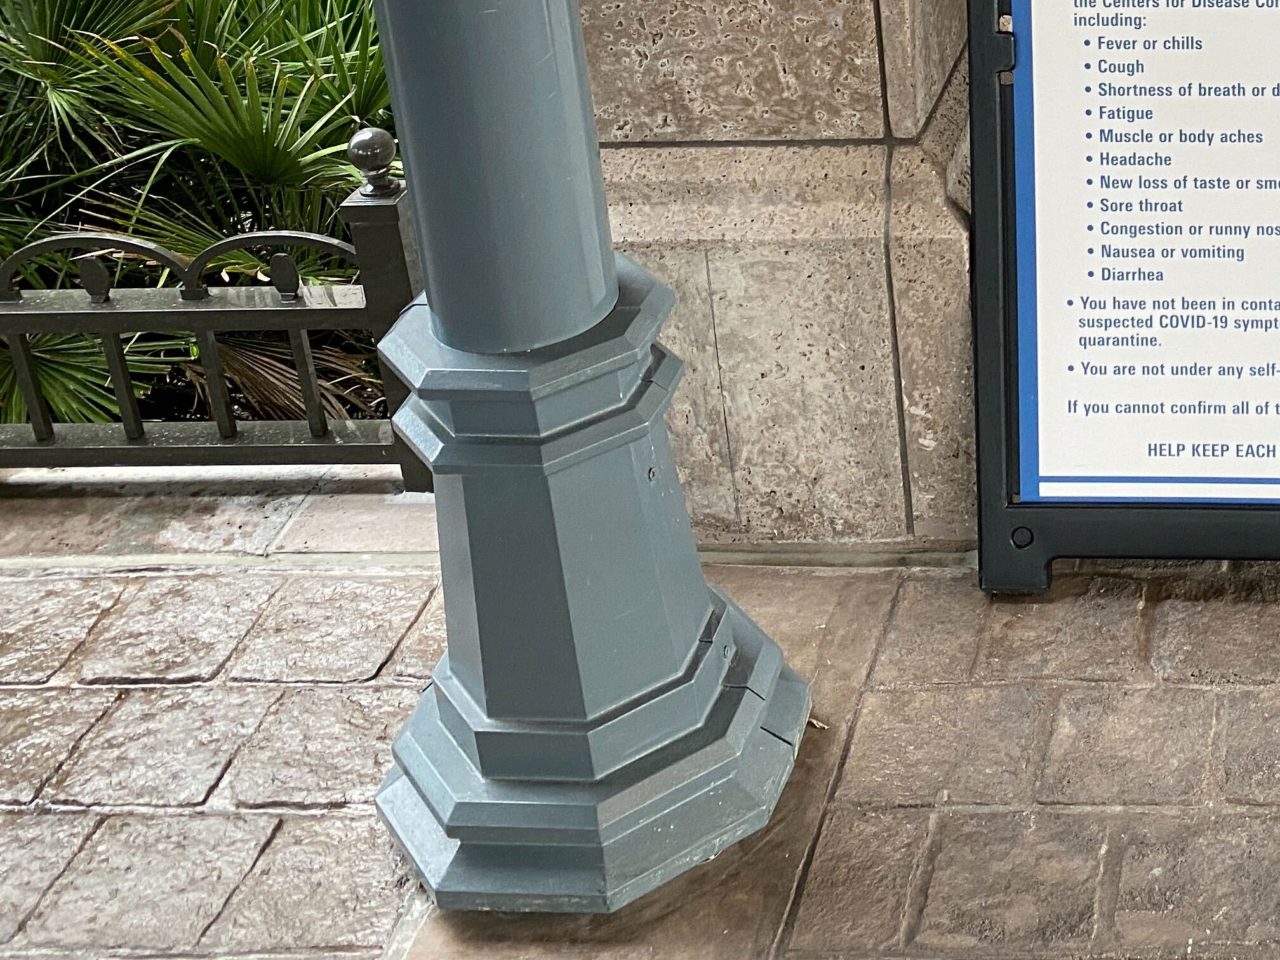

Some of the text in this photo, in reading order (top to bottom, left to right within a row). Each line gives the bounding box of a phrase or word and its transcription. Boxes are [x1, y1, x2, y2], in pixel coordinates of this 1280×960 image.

[1074, 12, 1146, 30] including:
[1098, 36, 1203, 50] Fever or chills
[1098, 59, 1144, 77] Cough
[1098, 82, 1173, 97] Shortness
[1178, 82, 1193, 97] of
[1198, 82, 1246, 97] breath
[1252, 86, 1267, 97] or
[1099, 105, 1153, 123] Fatigue
[1099, 129, 1263, 146] Muscle or body aches
[1100, 152, 1172, 166] Headache
[1100, 175, 1133, 189] New
[1139, 175, 1168, 189] loss
[1173, 175, 1188, 189] of
[1193, 177, 1230, 190] taste
[1236, 179, 1251, 190] or
[1100, 198, 1183, 212] Sore throat
[1100, 221, 1183, 239] Congestion
[1189, 225, 1203, 235] or
[1209, 225, 1251, 239] runny
[1101, 244, 1244, 262] Nausea or vomiting
[1101, 267, 1164, 281] Diarrhea
[1080, 296, 1106, 310] You
[1113, 296, 1146, 310] have
[1152, 298, 1176, 310] not
[1181, 296, 1216, 310] been
[1222, 297, 1235, 311] in
[1078, 314, 1153, 332] suspected
[1159, 314, 1228, 329] COVID-19
[1079, 333, 1162, 350] quarantine.
[1081, 361, 1107, 375] You
[1113, 365, 1136, 376] are
[1142, 364, 1165, 376] not
[1171, 362, 1213, 376] under
[1218, 366, 1244, 380] any
[1068, 400, 1078, 414] If
[1083, 403, 1109, 417] you
[1115, 402, 1165, 414] cannot
[1170, 400, 1226, 415] confirm
[1232, 400, 1249, 415] all
[1255, 401, 1270, 415] of
[1148, 443, 1186, 457] HELP
[1192, 443, 1230, 457] KEEP
[1236, 444, 1276, 458] EACH
